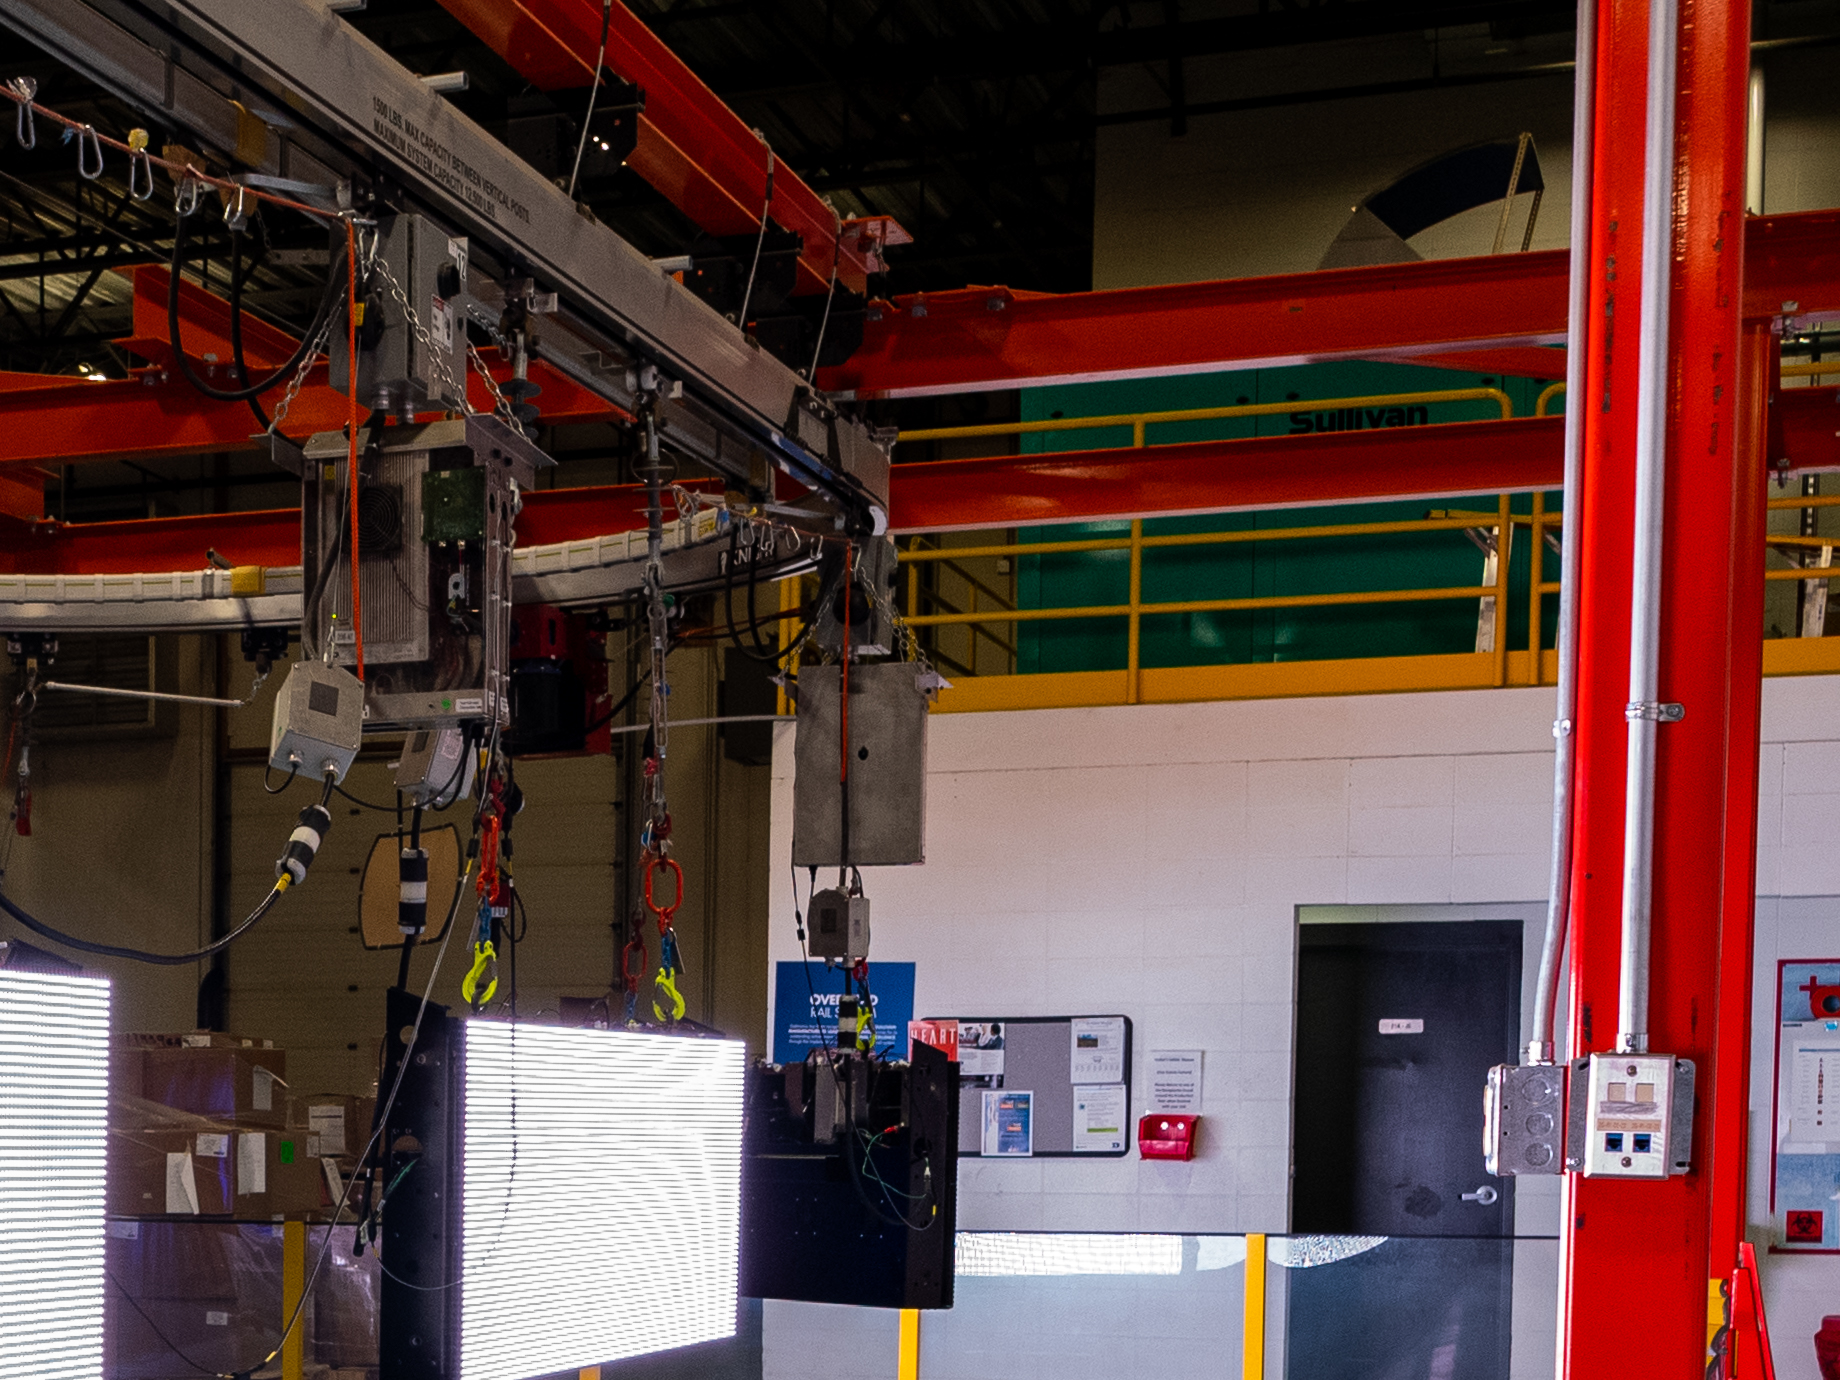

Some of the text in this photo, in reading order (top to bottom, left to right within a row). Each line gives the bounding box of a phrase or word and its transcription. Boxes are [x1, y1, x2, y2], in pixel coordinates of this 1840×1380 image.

[372, 96, 389, 119] 1500
[404, 119, 420, 144] MAX
[419, 130, 452, 165] CAPACITY
[451, 154, 482, 189] BETWEEN
[482, 177, 511, 212] VERTICAL
[373, 118, 406, 153] MAXIMUM
[406, 143, 433, 173] SYSTEM
[433, 162, 464, 195] CAPACITY
[1289, 406, 1428, 435] Sullivan
[911, 1028, 957, 1045] HEART
